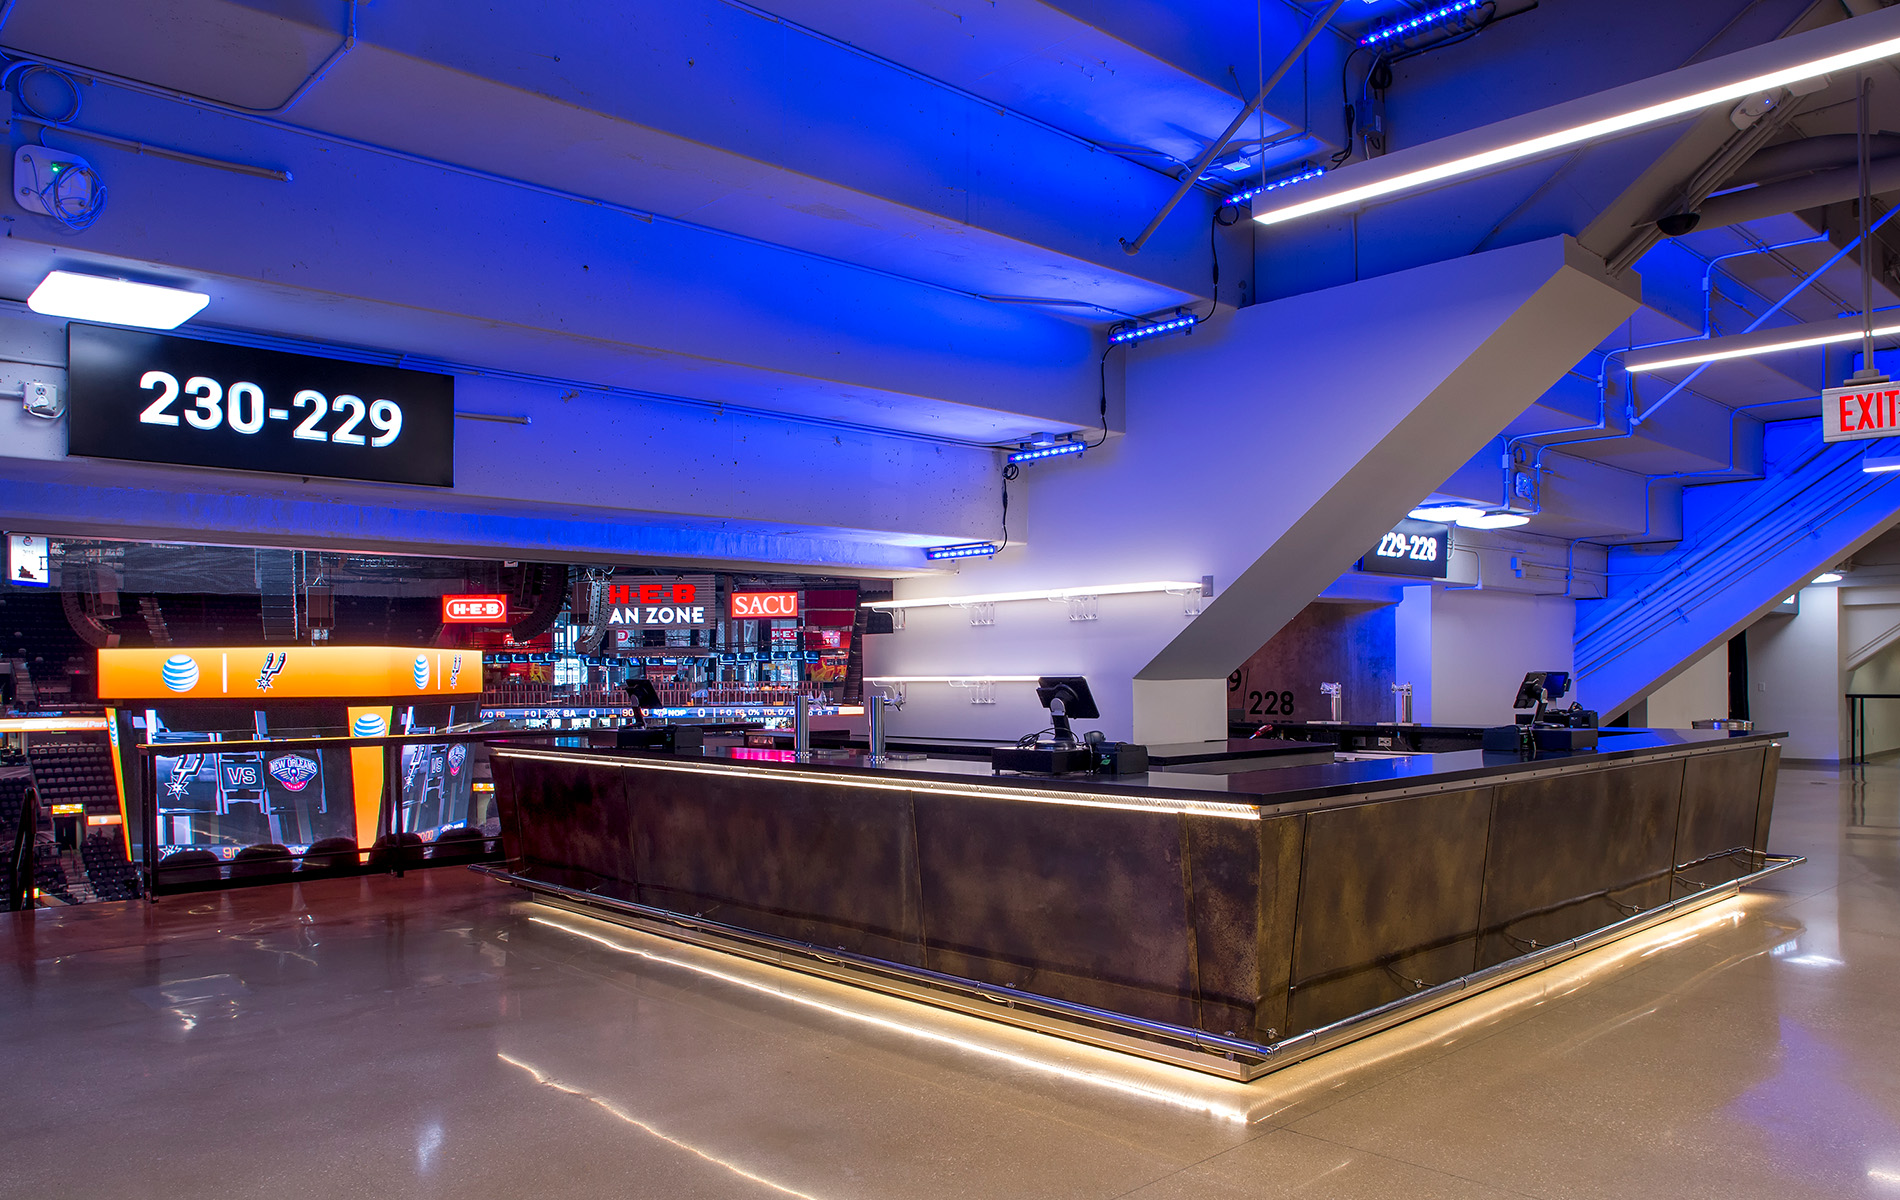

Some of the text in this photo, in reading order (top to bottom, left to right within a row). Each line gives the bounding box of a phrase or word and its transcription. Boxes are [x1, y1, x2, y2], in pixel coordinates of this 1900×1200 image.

[139, 370, 403, 448] 230-229
[1839, 390, 1900, 432] EXIT
[1376, 531, 1437, 562] 229-228
[608, 606, 705, 624] AN ZONE
[735, 595, 796, 615] SACU
[1249, 690, 1294, 715] 228
[667, 709, 687, 717] NOP
[269, 758, 318, 773] NEW ORLEANS
[227, 767, 257, 785] VS
